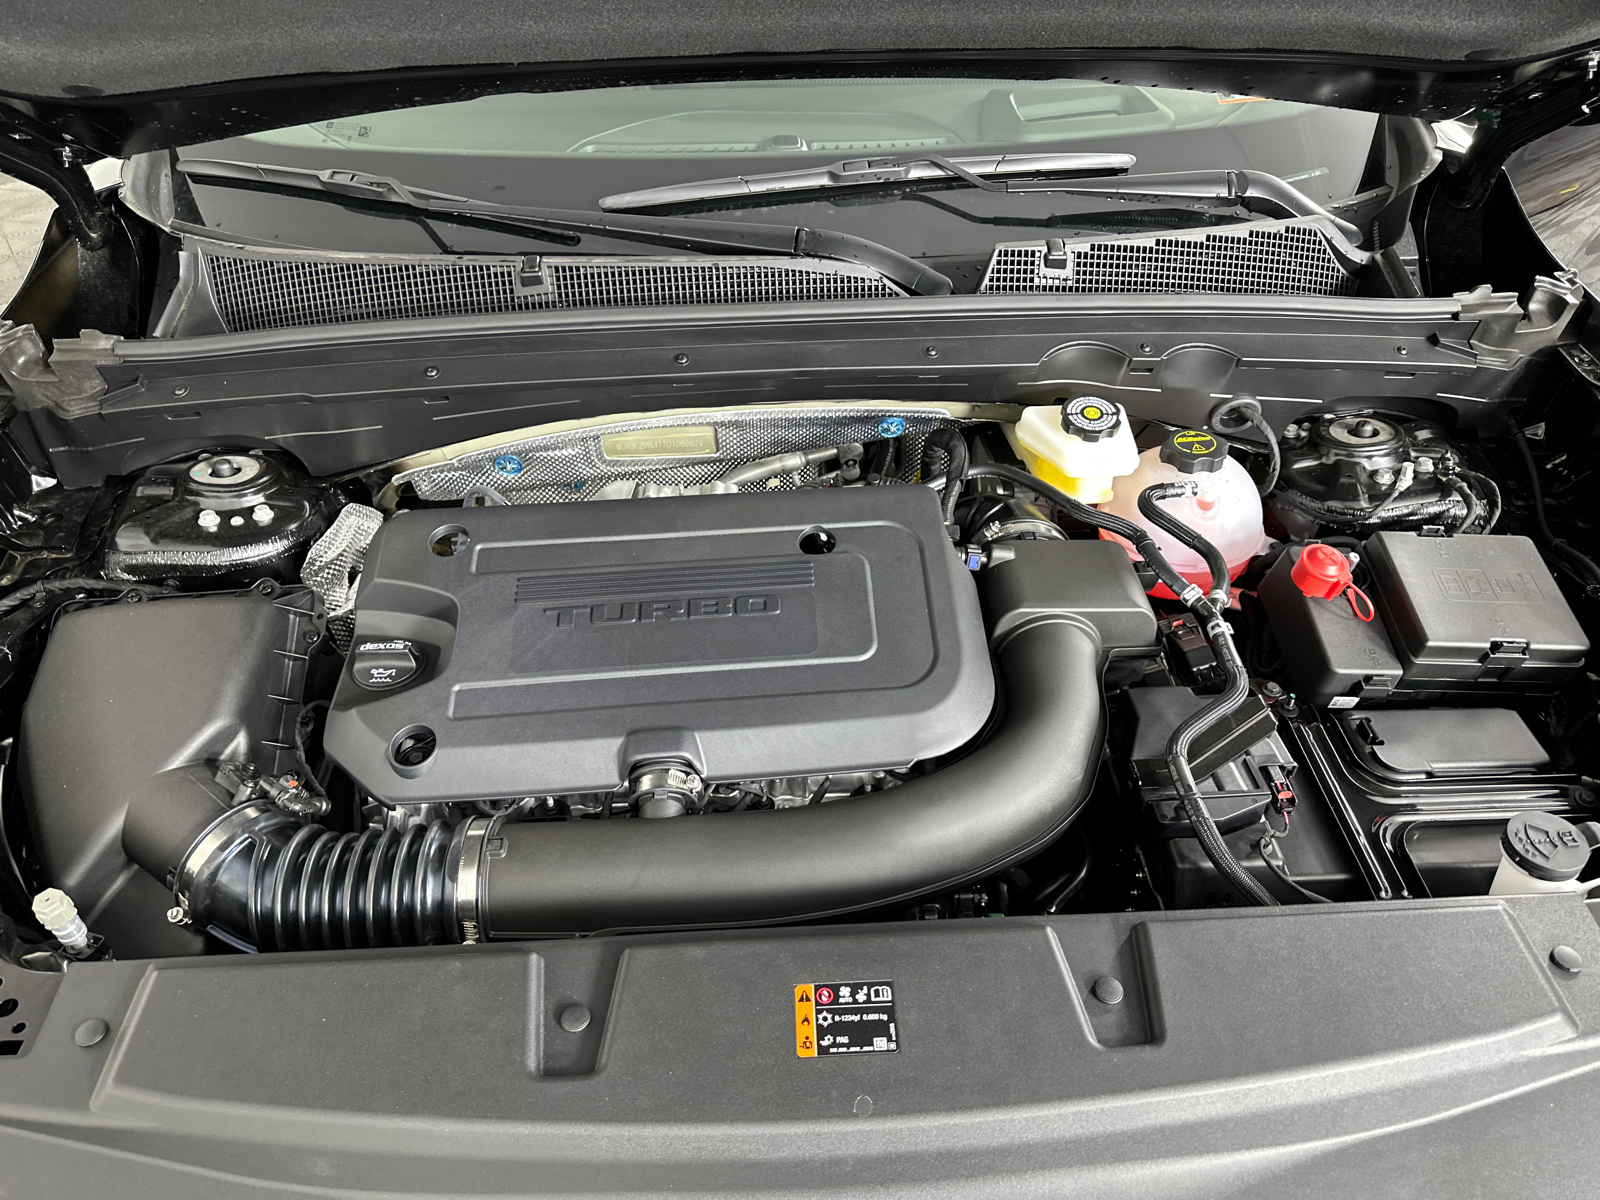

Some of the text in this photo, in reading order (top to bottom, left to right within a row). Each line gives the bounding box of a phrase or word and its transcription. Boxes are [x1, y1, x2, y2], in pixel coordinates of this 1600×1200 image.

[543, 594, 781, 628] TURBO
[359, 642, 405, 651] dexos
[834, 1014, 861, 1022] R-1234yf
[835, 1036, 850, 1044] PAG
